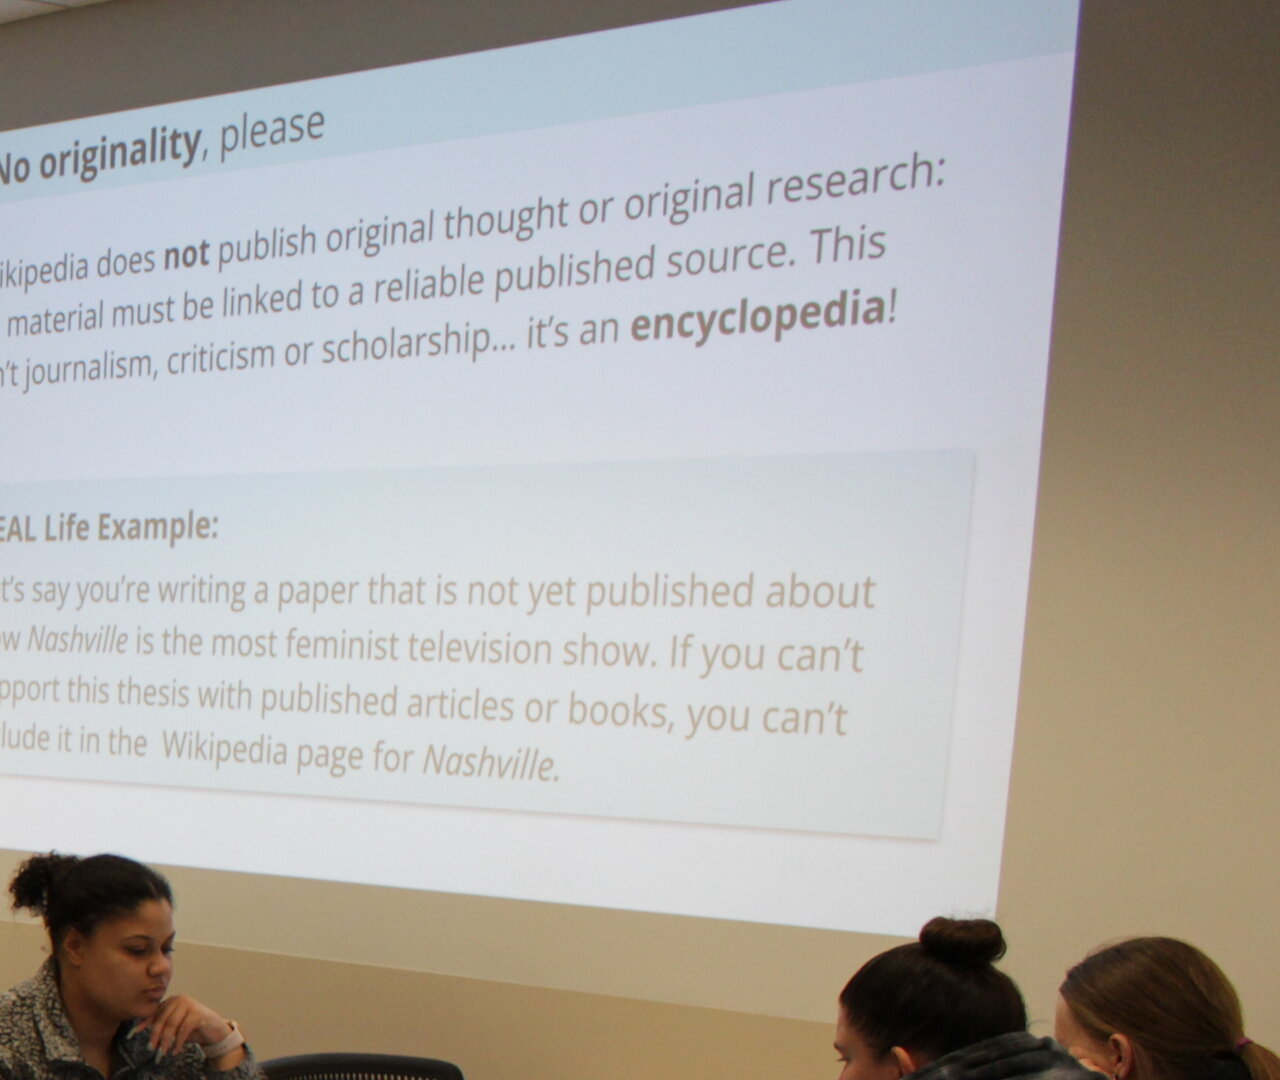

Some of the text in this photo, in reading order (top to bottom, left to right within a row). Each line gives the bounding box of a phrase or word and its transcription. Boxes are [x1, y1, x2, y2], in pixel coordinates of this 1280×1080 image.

[40, 126, 207, 183] originality,
[221, 111, 324, 163] please
[97, 248, 155, 277] does
[164, 240, 210, 270] not
[219, 224, 316, 273] publish
[326, 210, 434, 258] original
[445, 196, 569, 242] thought
[579, 197, 614, 225] or
[625, 171, 754, 226] original
[768, 151, 945, 204] research:
[8, 300, 103, 336] material
[113, 297, 175, 327] must
[183, 291, 214, 320] be
[223, 279, 302, 317] linked
[312, 282, 339, 309] to
[349, 282, 363, 306] a
[375, 263, 484, 303] reliable
[495, 244, 655, 303] published
[667, 242, 795, 277] source.
[810, 224, 886, 264] This
[23, 351, 158, 394] journalism,
[168, 341, 274, 374] criticism
[285, 342, 313, 366] or
[528, 316, 568, 348] it's
[580, 318, 618, 345] an
[631, 288, 897, 348] encyclopedia!
[45, 513, 89, 541] Life
[99, 509, 218, 548] Example:
[32, 581, 70, 611] say
[76, 575, 150, 611] you're
[158, 574, 246, 613] writing
[254, 581, 268, 604] a
[278, 581, 359, 613] paper
[368, 573, 426, 605] that
[436, 574, 457, 605] is
[468, 577, 519, 606] not
[526, 577, 576, 616] yet
[586, 572, 754, 616] published
[766, 572, 876, 609] about
[28, 624, 128, 654] Nashville
[137, 626, 154, 655] is
[162, 626, 203, 656] the
[212, 631, 277, 658] most
[286, 627, 399, 661] feminist
[408, 630, 551, 664] television
[563, 632, 656, 667] show.
[670, 633, 695, 669] If
[698, 641, 765, 680] you
[778, 638, 864, 673] can't
[68, 675, 109, 704] this
[118, 676, 189, 708] thesis
[198, 680, 252, 710] with
[261, 682, 398, 720] published
[407, 688, 514, 722] articles
[525, 698, 559, 723] or
[569, 691, 674, 734] books,
[685, 705, 750, 740] you
[763, 701, 848, 736] can't
[58, 725, 72, 752] it
[80, 726, 100, 753] in
[108, 727, 147, 757] the
[163, 730, 287, 770] Wikipedia
[297, 744, 363, 778] page
[373, 740, 414, 772] for
[423, 744, 559, 782] Nashville.
